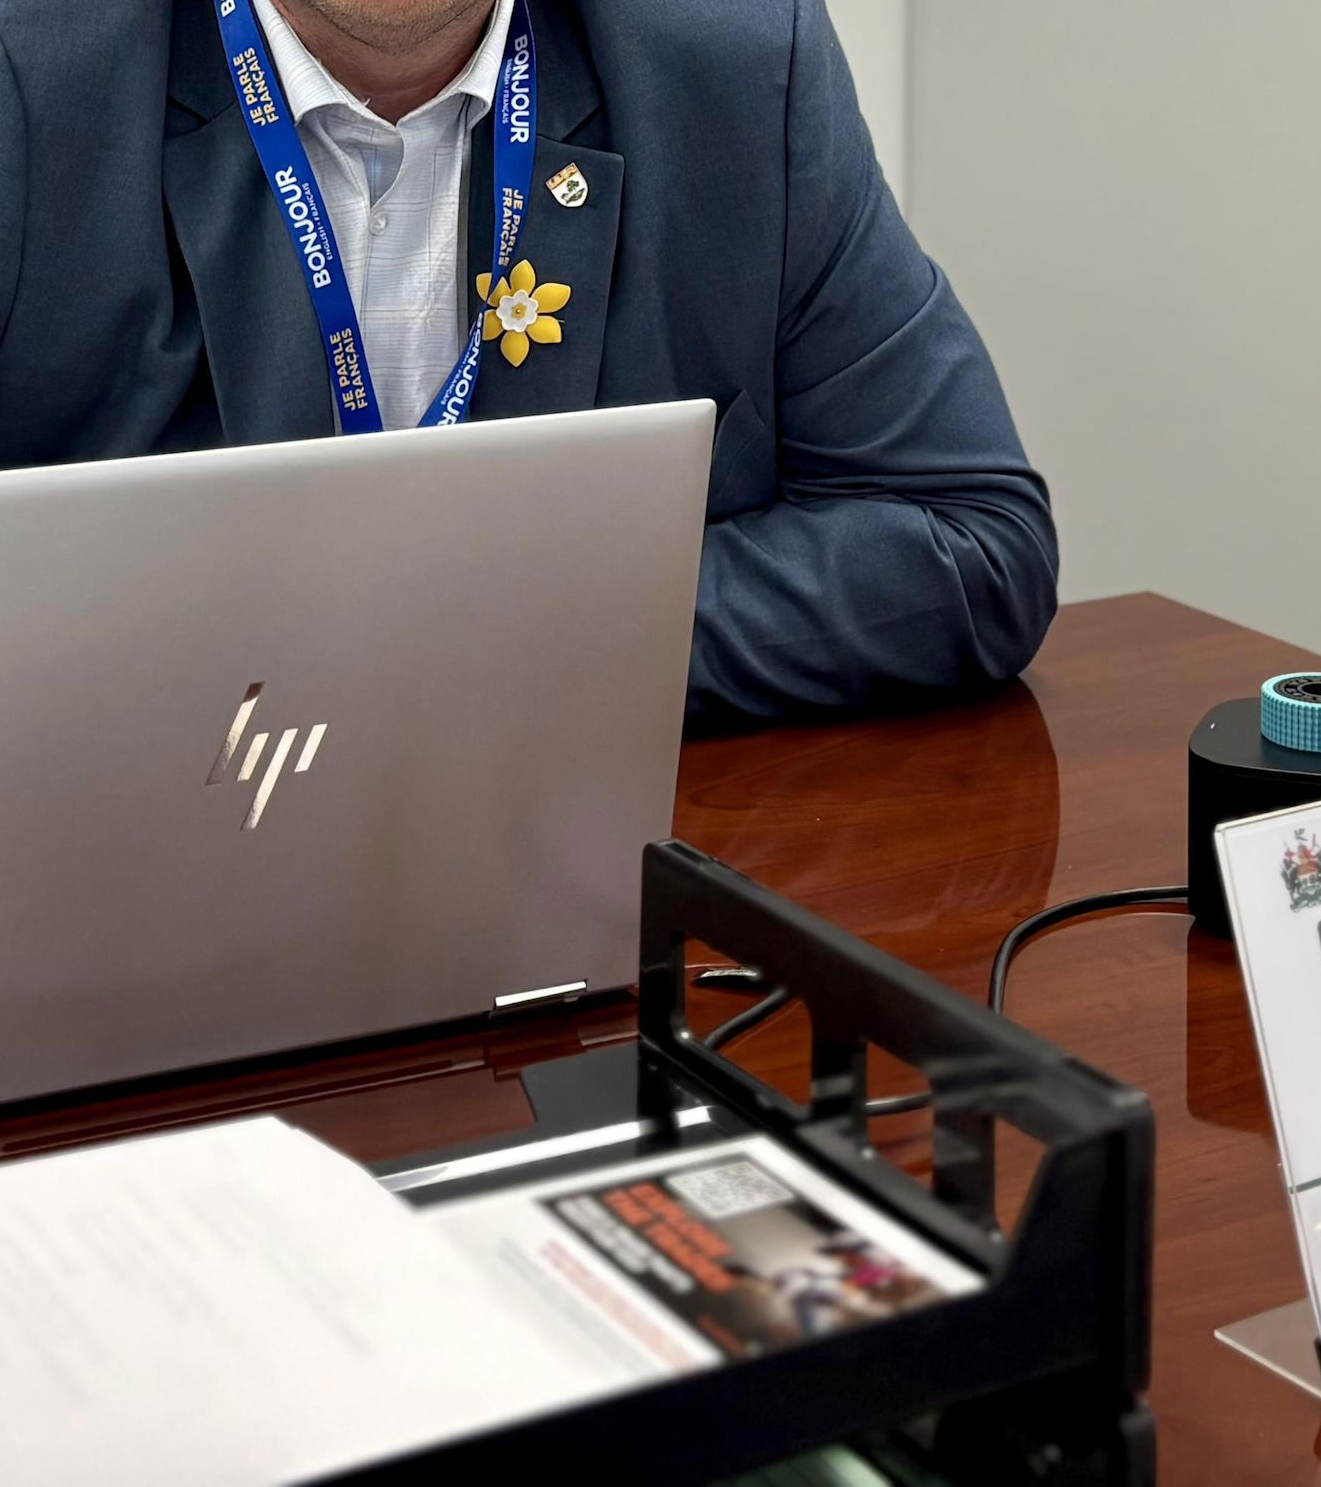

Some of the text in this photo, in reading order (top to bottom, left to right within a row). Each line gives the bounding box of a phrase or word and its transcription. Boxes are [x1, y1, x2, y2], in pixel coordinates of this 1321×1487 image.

[233, 53, 266, 126] JE PARLE
[244, 47, 279, 123] FRANÇAIS
[509, 34, 530, 143] BONJOUR
[275, 165, 332, 289] BONJOUR
[513, 189, 524, 210] JE
[329, 332, 356, 411] JE PARLE
[341, 327, 368, 409] FRANÇAIS
